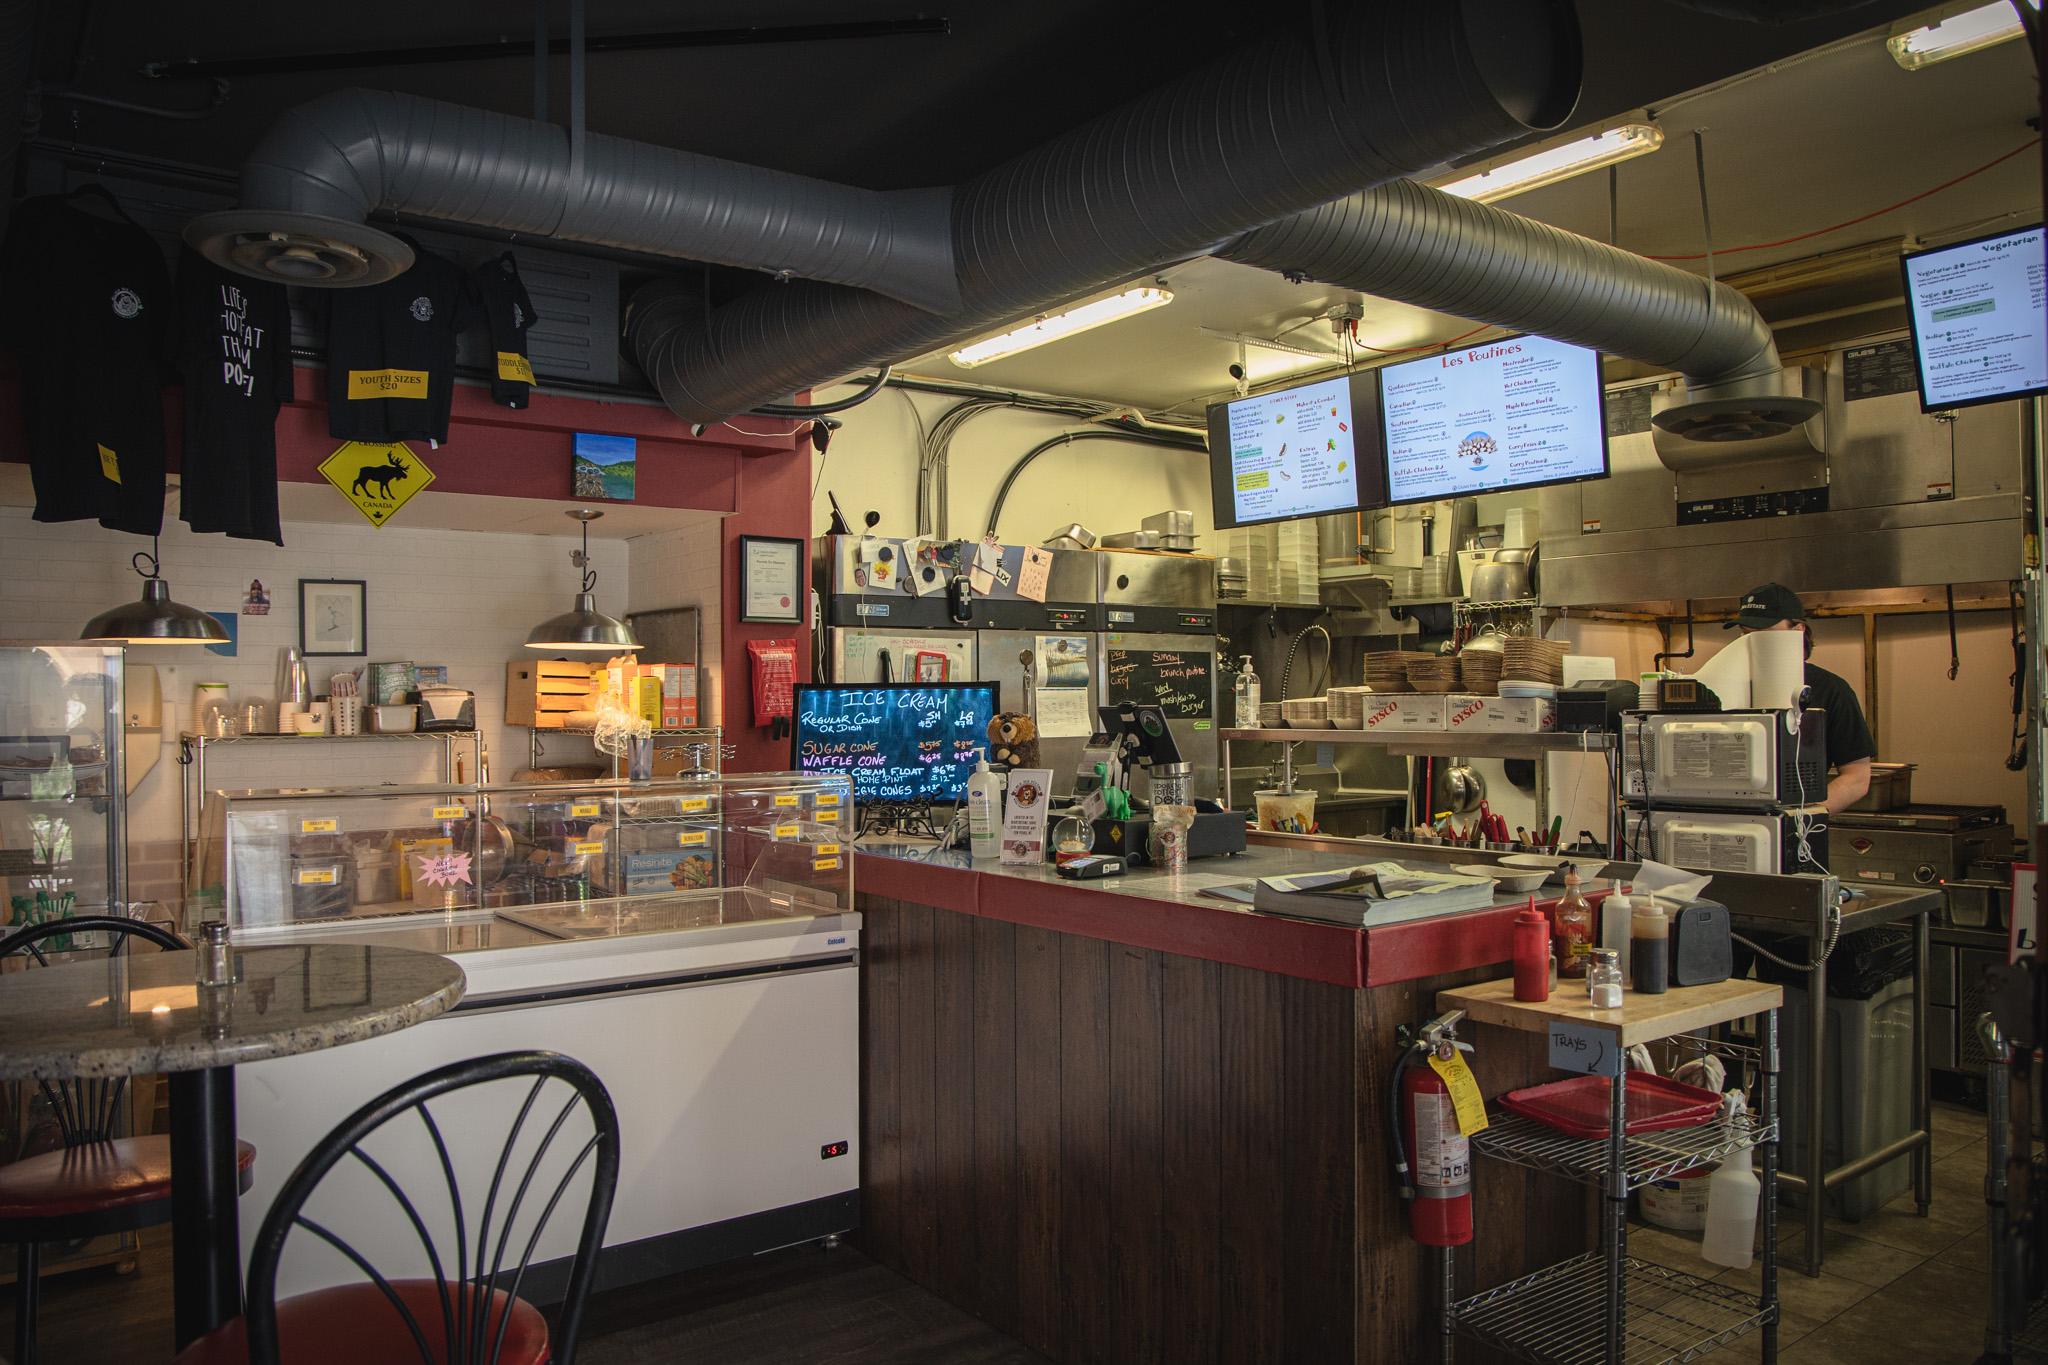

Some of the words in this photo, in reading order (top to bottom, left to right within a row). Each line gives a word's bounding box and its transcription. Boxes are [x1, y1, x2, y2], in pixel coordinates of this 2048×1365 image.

[1442, 355, 1464, 369] Les
[1468, 343, 1522, 363] Poutines
[359, 375, 391, 385] YOUTH
[394, 375, 422, 384] SIZES
[379, 382, 398, 391] $20
[362, 501, 393, 510] CANADA
[1152, 652, 1181, 665] Sunday
[839, 691, 885, 707] ICE
[897, 692, 948, 714] CREAM
[1367, 701, 1398, 727] SYSCO
[1452, 699, 1484, 726] SYSCO
[819, 725, 834, 733] OR
[801, 740, 846, 755] SUGAR
[849, 740, 879, 753] CONE
[803, 754, 853, 767] WAFFLE
[857, 752, 887, 767] CONE
[851, 767, 886, 778] CREAM
[890, 767, 925, 776] FLOAT
[857, 776, 880, 784] HOME
[882, 775, 908, 784] PINT
[880, 784, 912, 796] CONES
[1551, 1033, 1587, 1053] TRAYS
